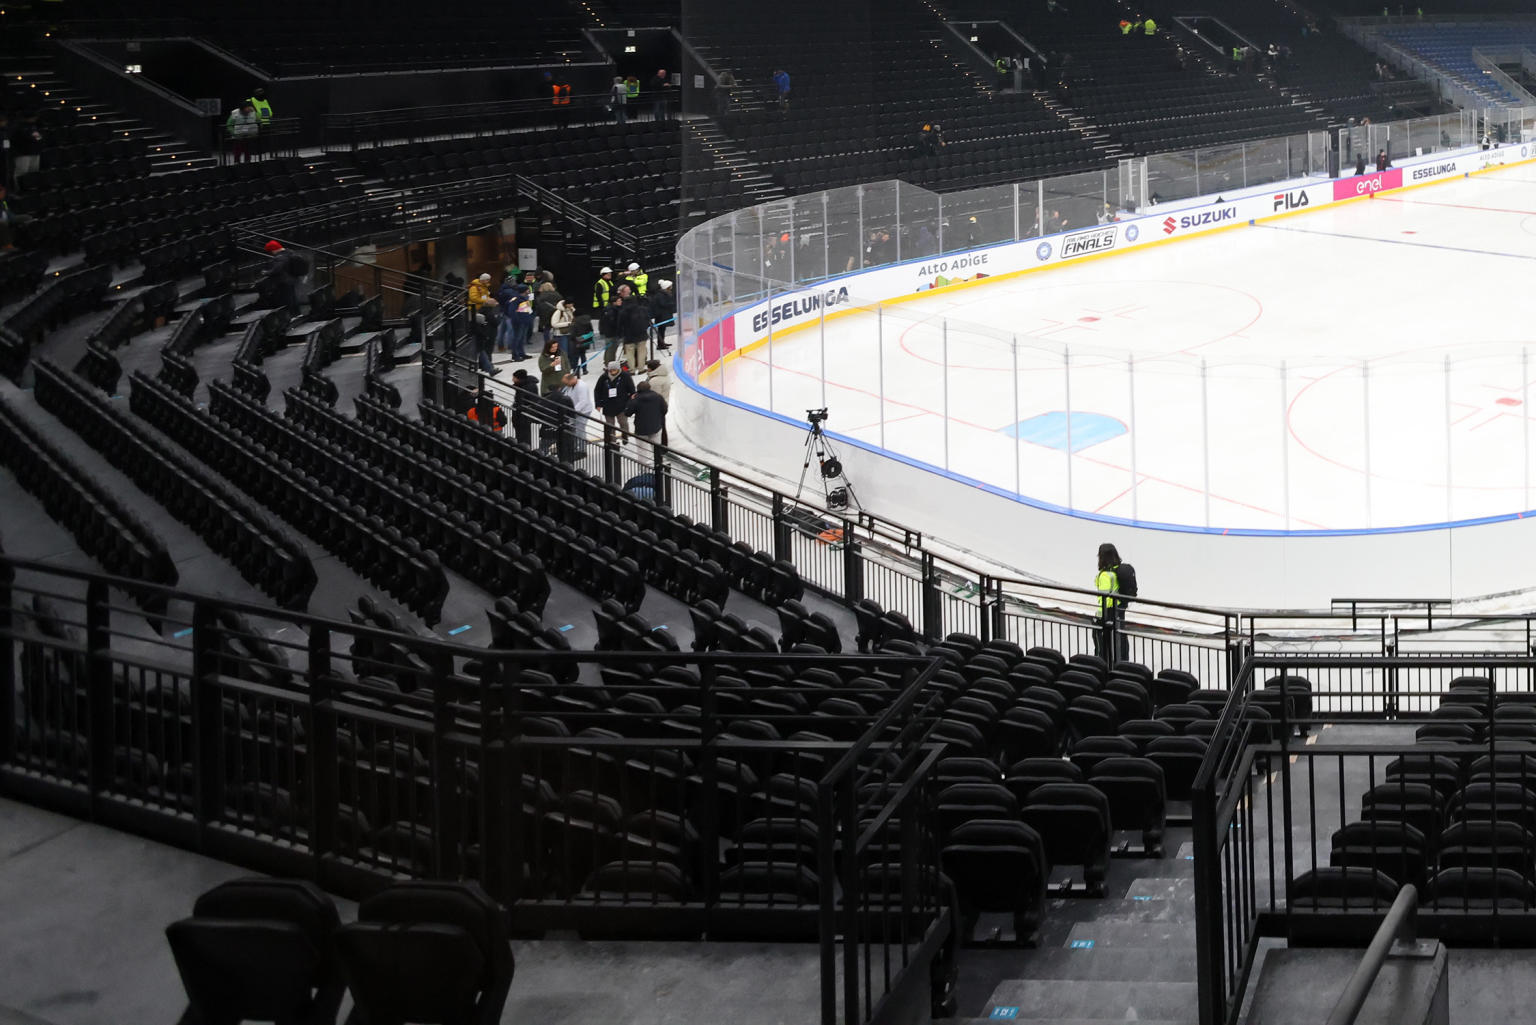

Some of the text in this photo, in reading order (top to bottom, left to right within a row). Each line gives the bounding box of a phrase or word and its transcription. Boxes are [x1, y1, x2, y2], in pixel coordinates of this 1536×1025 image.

[1412, 162, 1456, 180] ESSELUNGA
[1356, 175, 1382, 193] enel
[1273, 190, 1310, 212] FILA
[1180, 207, 1237, 228] SUZUKI
[1064, 235, 1113, 255] FINALS
[753, 286, 849, 333] ESSELUNGA
